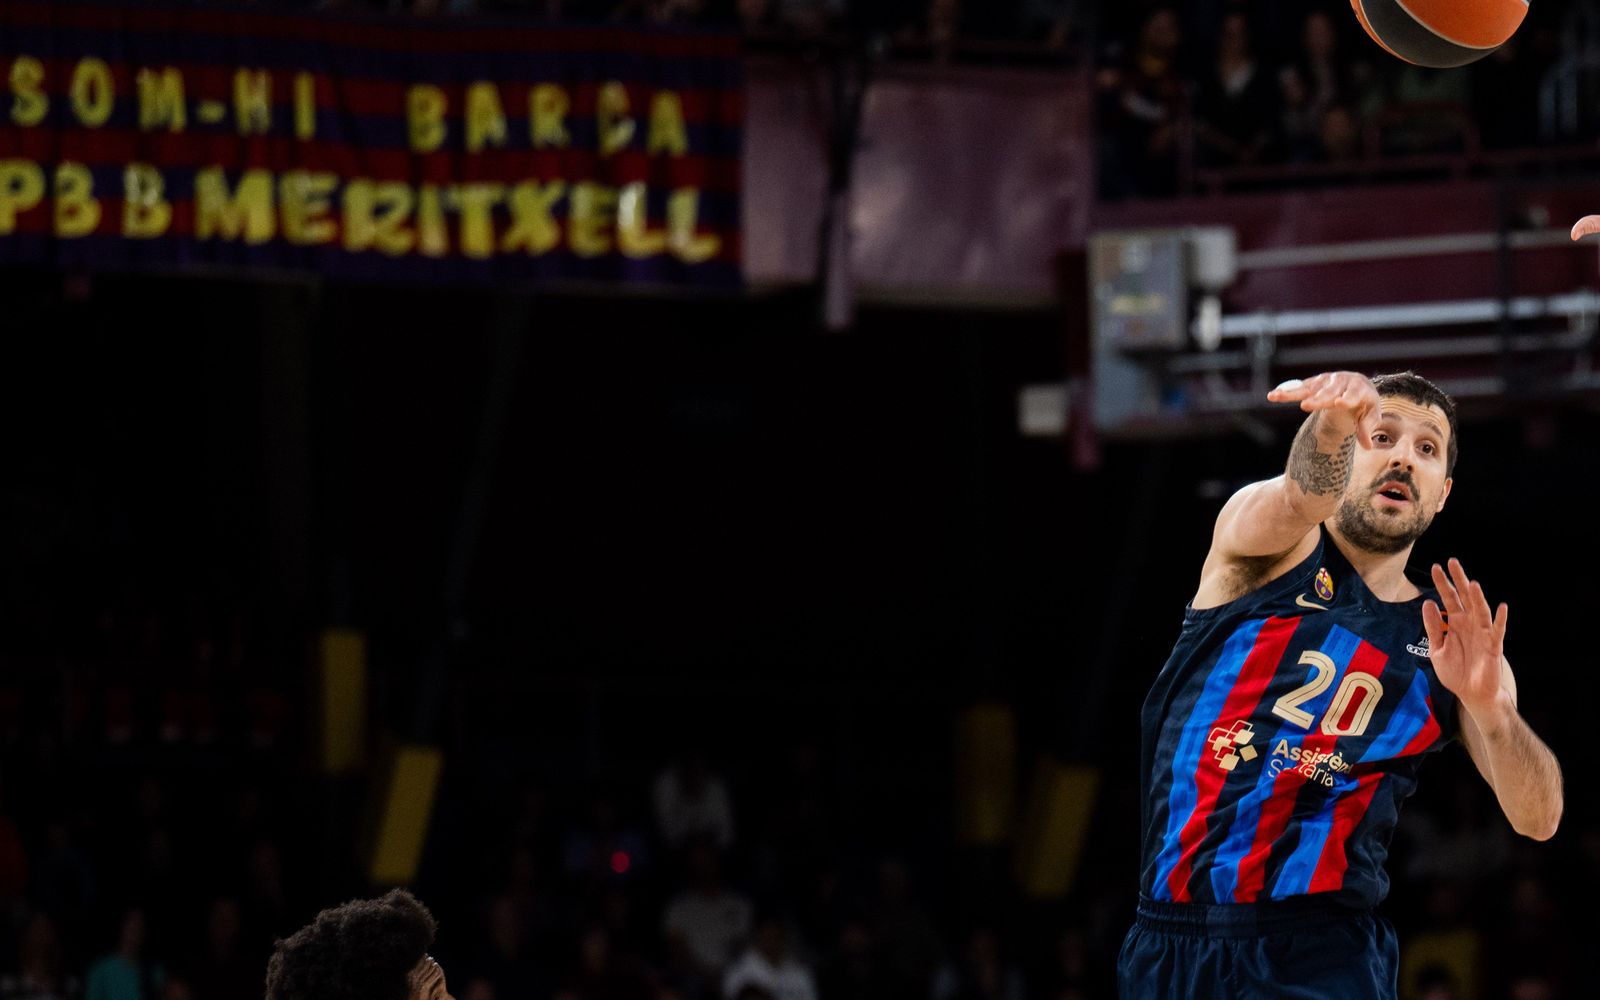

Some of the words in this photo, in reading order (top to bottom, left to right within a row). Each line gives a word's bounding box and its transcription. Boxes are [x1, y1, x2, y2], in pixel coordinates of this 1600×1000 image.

[6, 55, 317, 141] SOM-HI
[194, 167, 721, 264] MERITXELL
[1272, 650, 1384, 736] 20
